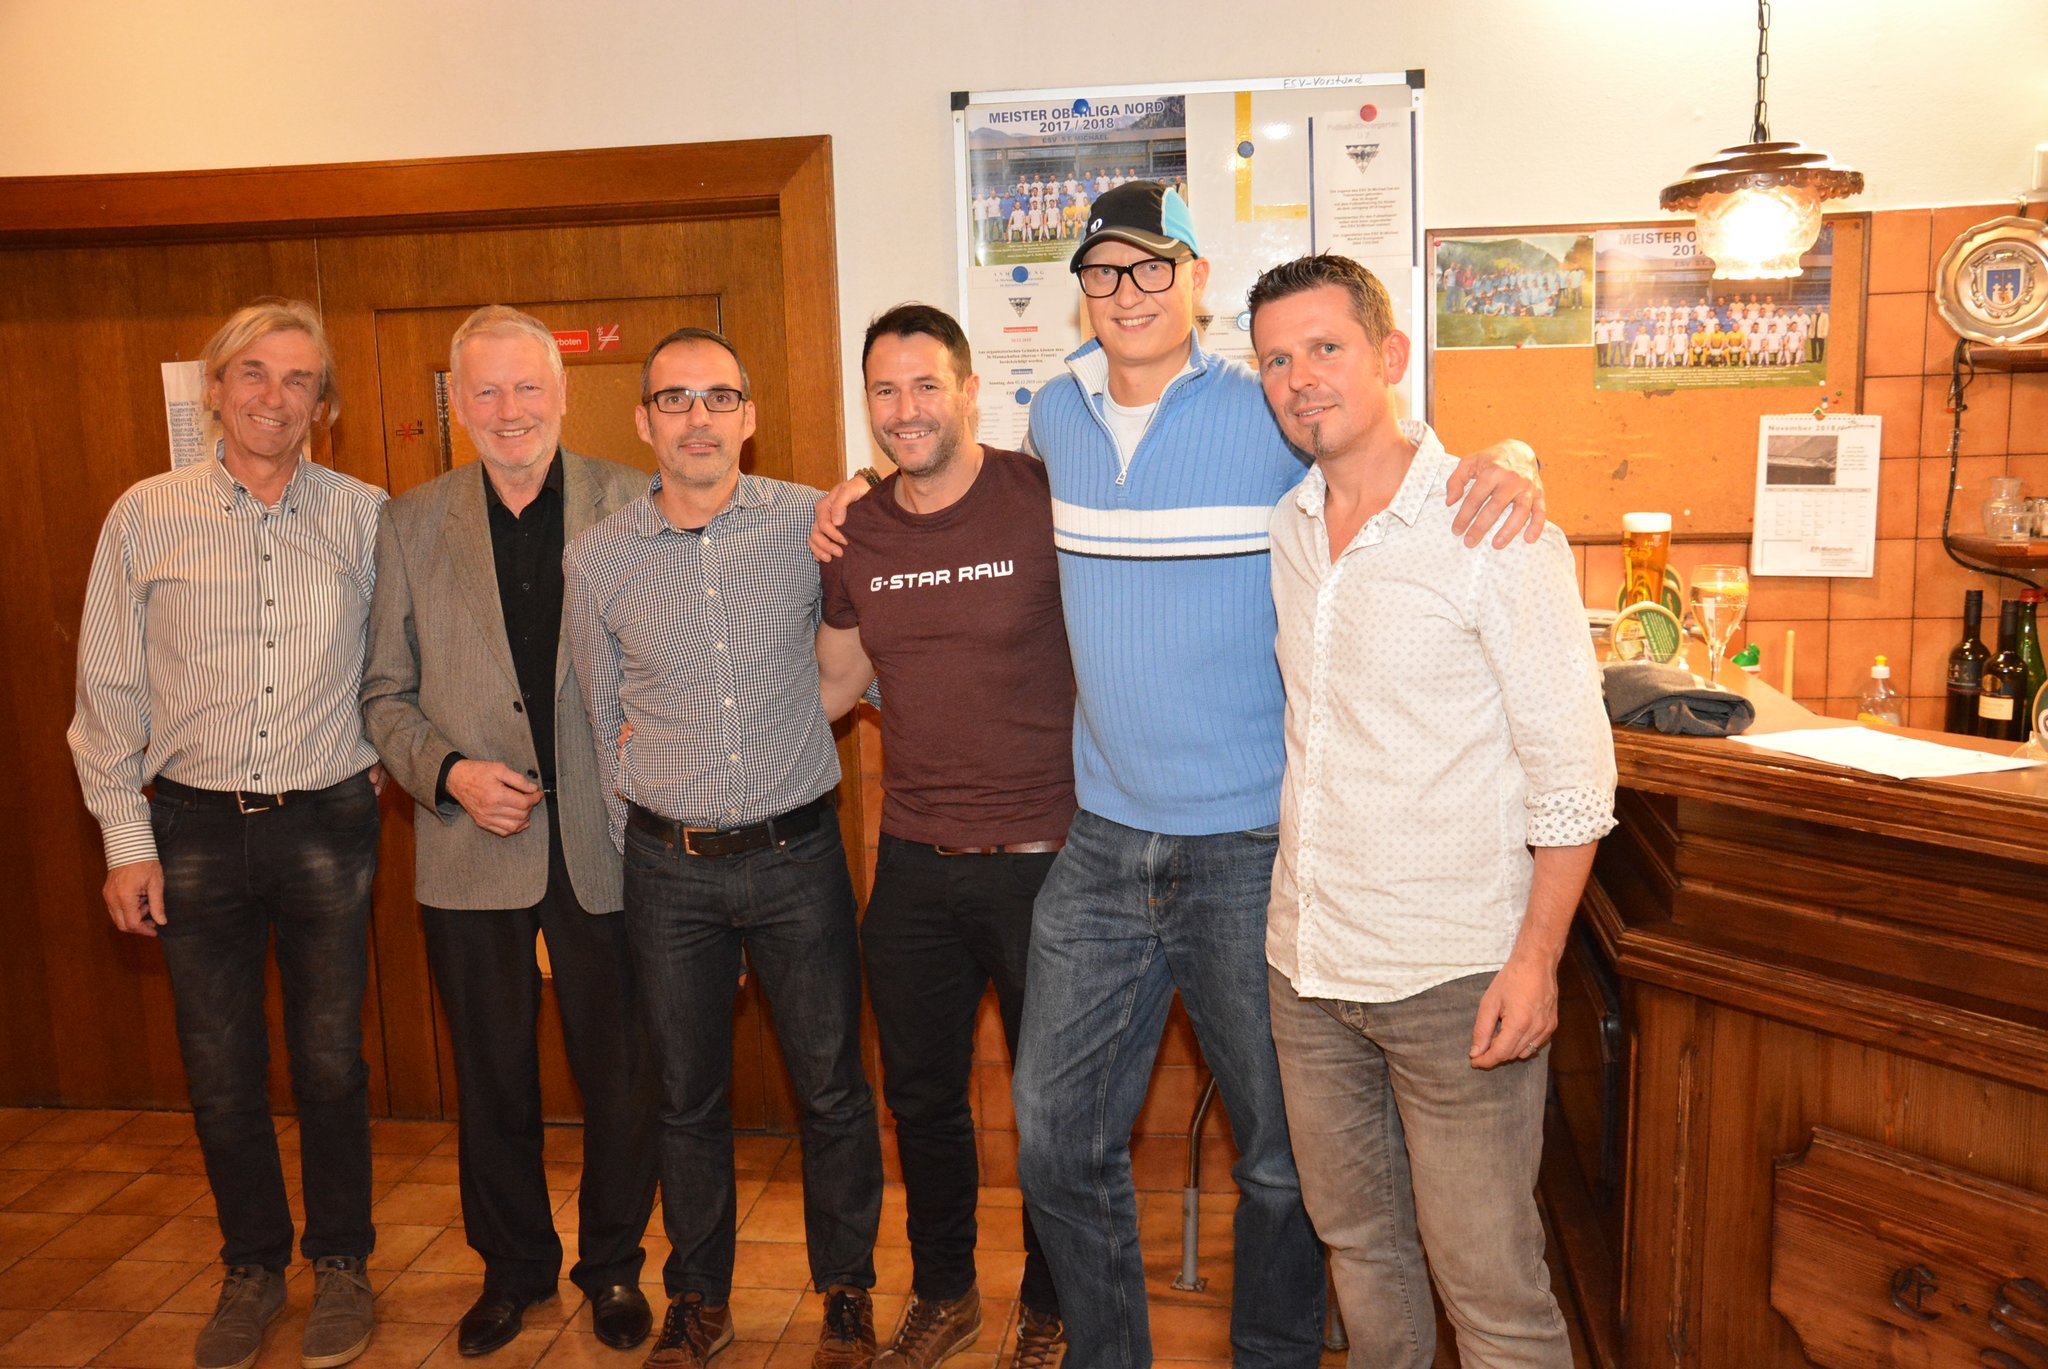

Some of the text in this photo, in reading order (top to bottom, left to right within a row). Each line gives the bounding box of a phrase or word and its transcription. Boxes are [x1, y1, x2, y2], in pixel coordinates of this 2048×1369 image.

[989, 109, 1047, 124] MEISTER
[1124, 101, 1164, 115] NORD
[1039, 121, 1070, 133] 2017
[1083, 117, 1114, 130] 2018
[1619, 231, 1681, 245] MEISTER
[555, 338, 582, 346] rboten
[870, 559, 1014, 592] G-STAR RAW
